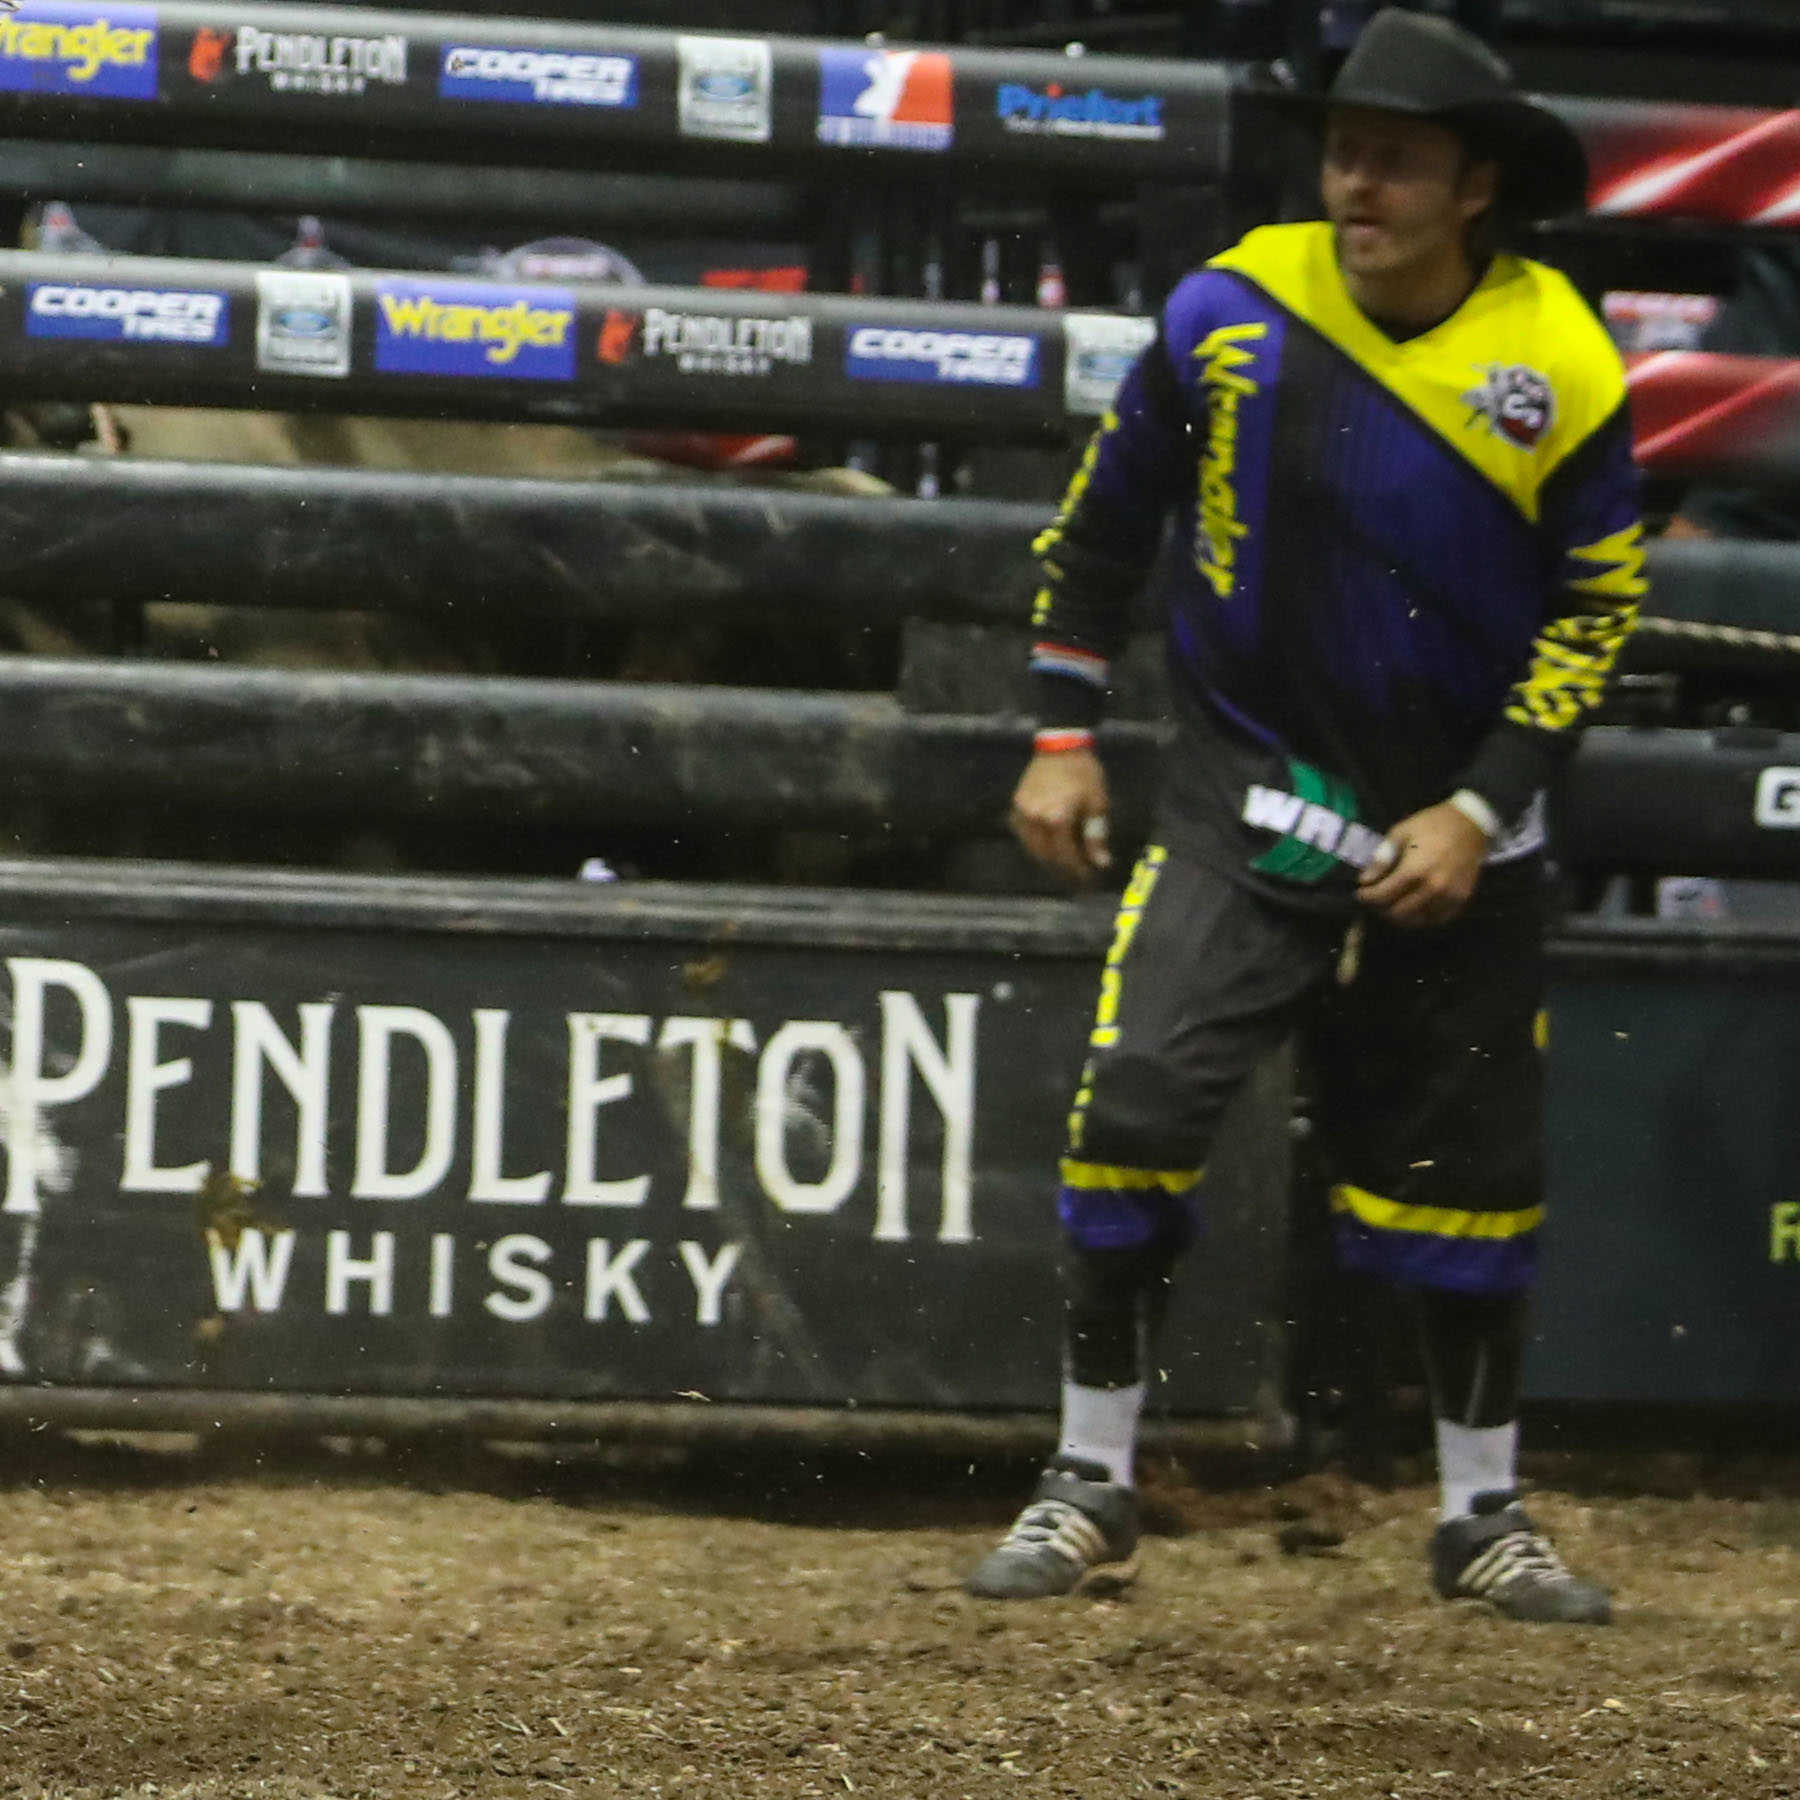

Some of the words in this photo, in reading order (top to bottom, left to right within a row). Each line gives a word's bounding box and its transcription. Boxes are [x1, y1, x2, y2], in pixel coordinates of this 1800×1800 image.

[446, 46, 635, 85] COOPER
[30, 284, 223, 320] COOPER
[381, 292, 573, 364] Wrangler
[849, 327, 1035, 365] COOPER
[2, 955, 982, 1244] PENDLETON
[206, 1226, 743, 1326] WHISKY
